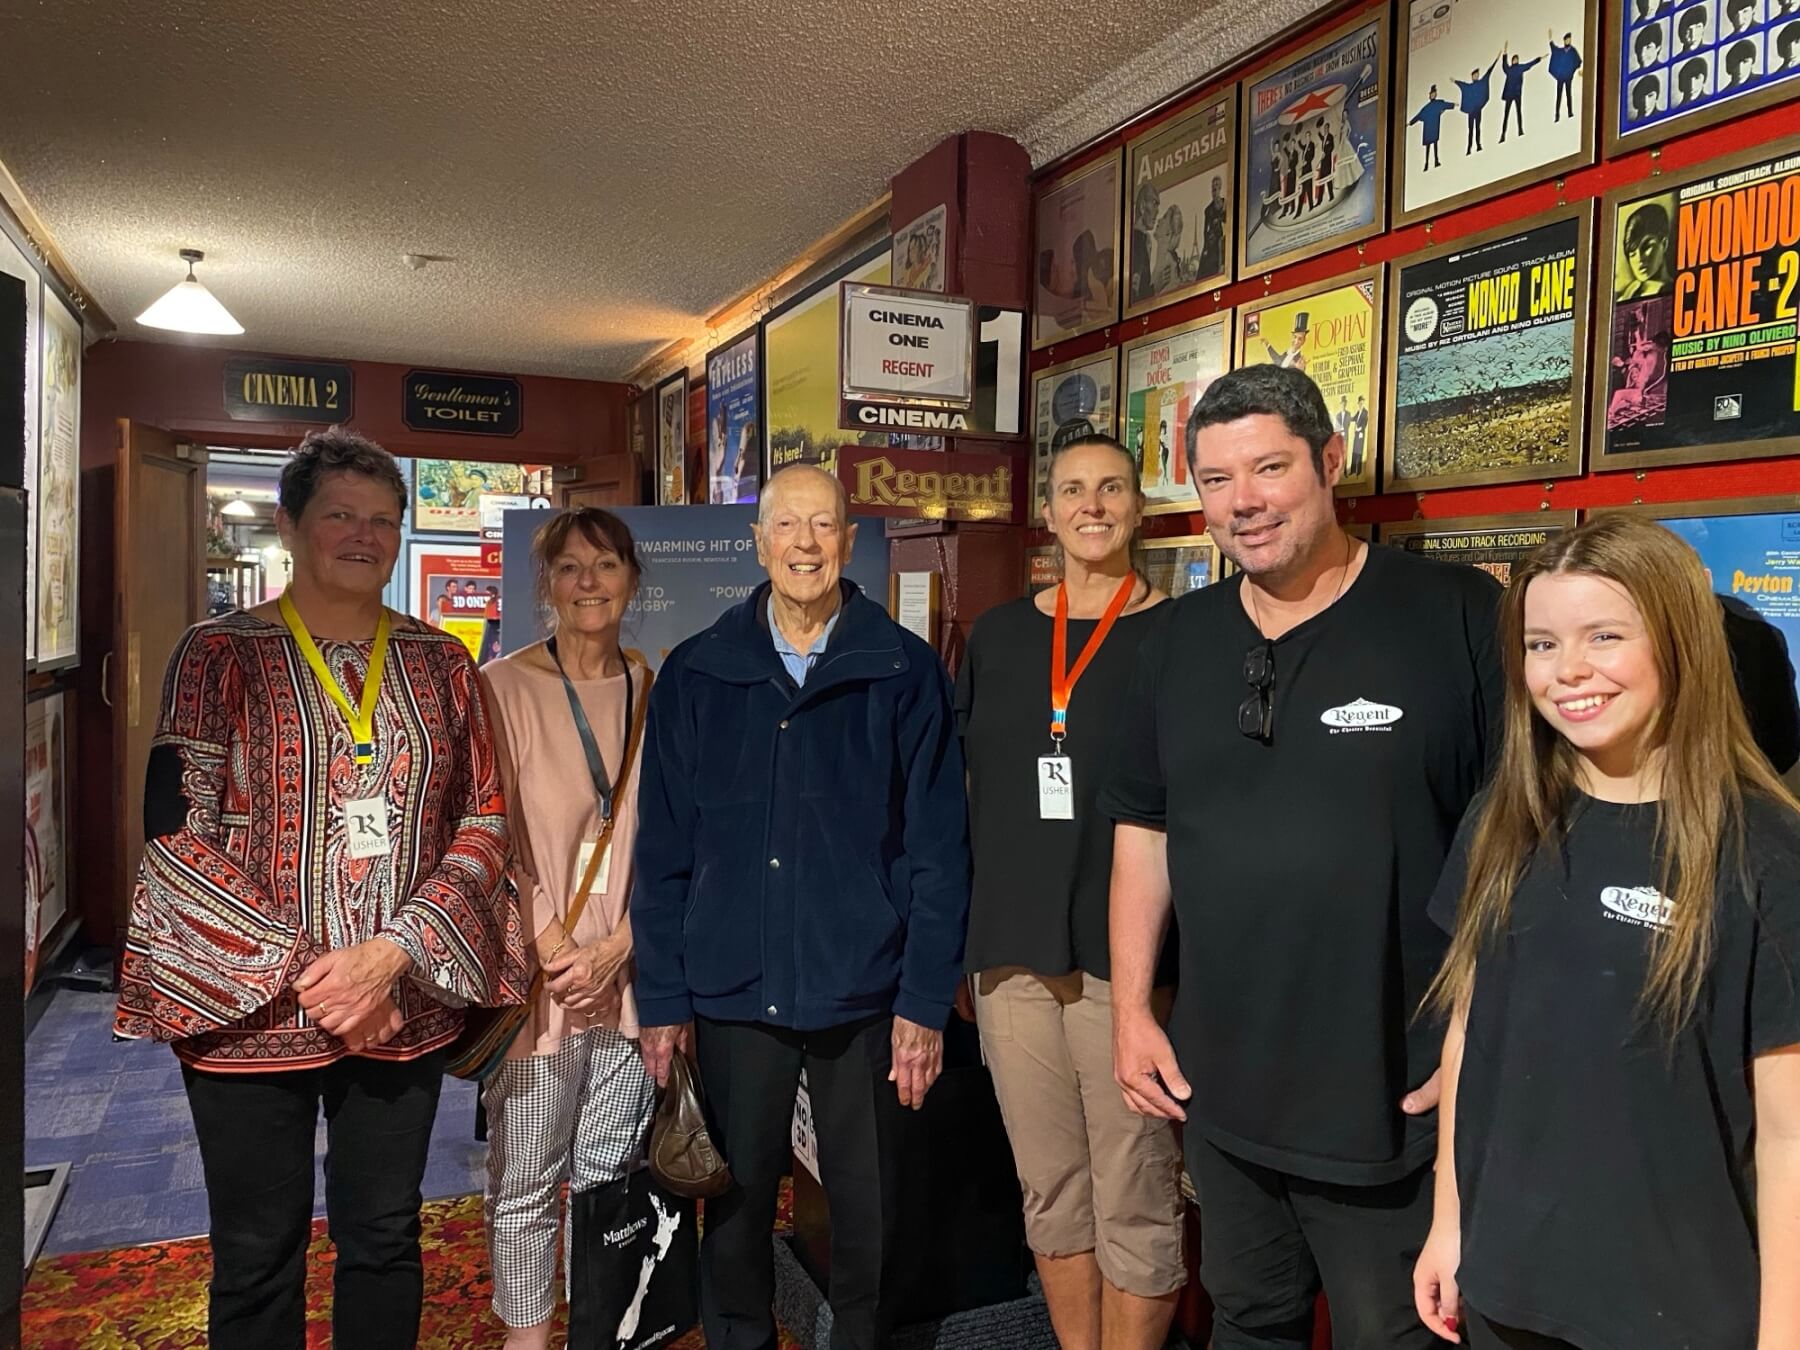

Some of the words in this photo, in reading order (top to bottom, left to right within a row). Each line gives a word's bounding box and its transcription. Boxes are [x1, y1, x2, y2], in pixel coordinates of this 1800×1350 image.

[1342, 31, 1377, 66] BUSINESS
[1137, 127, 1226, 185] ANASTASIA
[1680, 181, 1715, 199] ORIGINAL
[1717, 165, 1772, 189] SOUNDTRACK
[1677, 175, 1800, 270] MONDO
[1406, 286, 1434, 297] ORIGINAL
[1435, 279, 1461, 290] MOTION
[1463, 271, 1492, 283] PICTURE
[1493, 264, 1519, 276] SOUND
[1521, 257, 1544, 268] TRACK
[1547, 249, 1575, 261] ALBUM
[1468, 271, 1521, 331] MONDO
[1530, 256, 1575, 317] CANE
[1673, 256, 1762, 337] CANE
[869, 310, 944, 329] CINEMA
[1405, 343, 1426, 353] MUSIC
[1452, 329, 1490, 343] ORTOLANI
[1492, 325, 1509, 334] AND
[1511, 320, 1531, 331] NINO
[1533, 311, 1573, 325] OLIVIERO
[888, 333, 929, 348] ONE
[1312, 318, 1342, 349] TOP
[1672, 341, 1704, 357] MUSIC
[1706, 338, 1720, 351] BY
[1722, 333, 1746, 348] NINO
[1749, 324, 1796, 344] OLIVIERO
[882, 359, 935, 378] REGENT
[980, 310, 1022, 433] 1
[243, 372, 318, 408] CINEMA
[326, 380, 338, 409] 2
[414, 384, 511, 406] Gentlemen's
[424, 407, 501, 422] TOILET
[858, 406, 968, 430] CINEMA
[773, 447, 783, 466] It's
[784, 440, 804, 463] here!
[851, 456, 1013, 504] Regent
[710, 540, 731, 552] HIT
[734, 540, 753, 551] OF
[1442, 536, 1469, 549] SOUND
[1471, 535, 1496, 548] TRACK
[1498, 532, 1547, 546] RECORDING
[646, 586, 664, 598] TO
[1732, 569, 1793, 594] Peyton
[1331, 708, 1391, 724] Regent
[1042, 762, 1069, 785] R
[1043, 786, 1069, 795] USHER
[350, 814, 384, 838] R
[353, 839, 386, 851] USHER
[603, 1217, 647, 1246] Matthews
